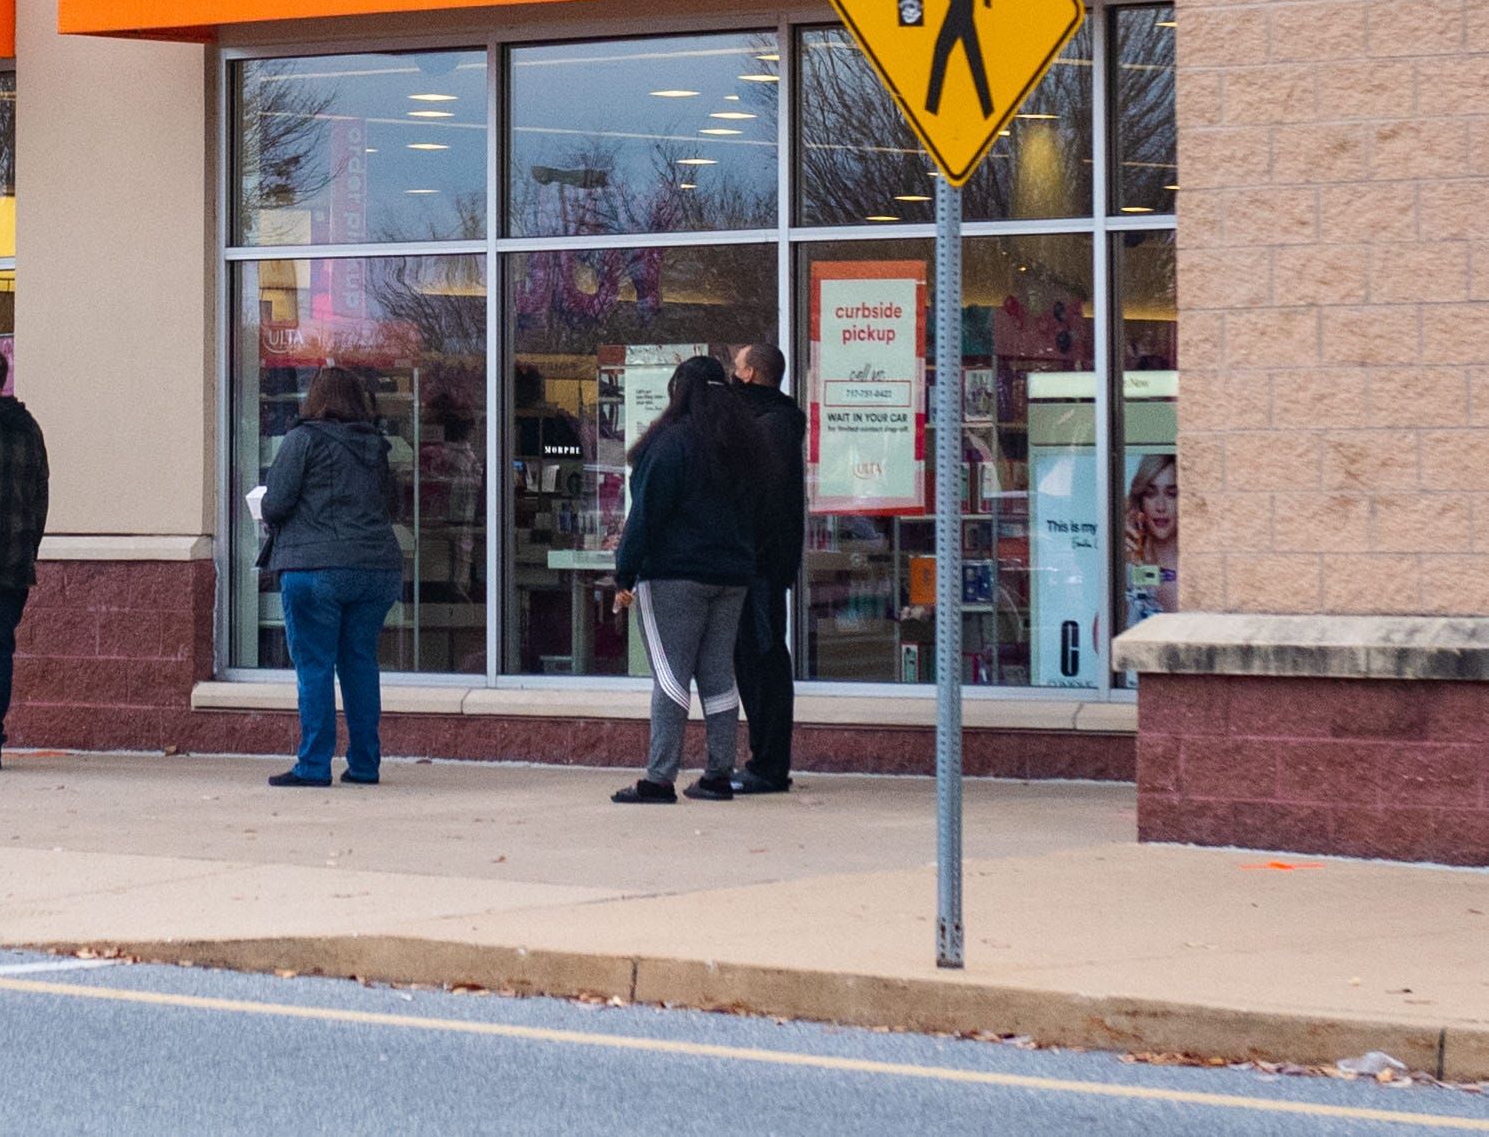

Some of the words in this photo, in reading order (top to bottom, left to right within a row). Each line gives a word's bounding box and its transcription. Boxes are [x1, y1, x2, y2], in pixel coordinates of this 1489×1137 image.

[344, 212, 364, 309] pikup
[835, 302, 903, 319] curbside
[269, 329, 304, 346] ULTA
[842, 324, 897, 346] pickup
[827, 413, 850, 422] WAIT
[853, 413, 863, 422] IN
[865, 413, 888, 422] YOUR
[890, 413, 908, 422] CAR
[544, 445, 581, 455] MORPHE
[857, 463, 883, 475] ULTA
[1047, 519, 1069, 533] This
[1070, 520, 1081, 533] is
[1081, 523, 1098, 535] my
